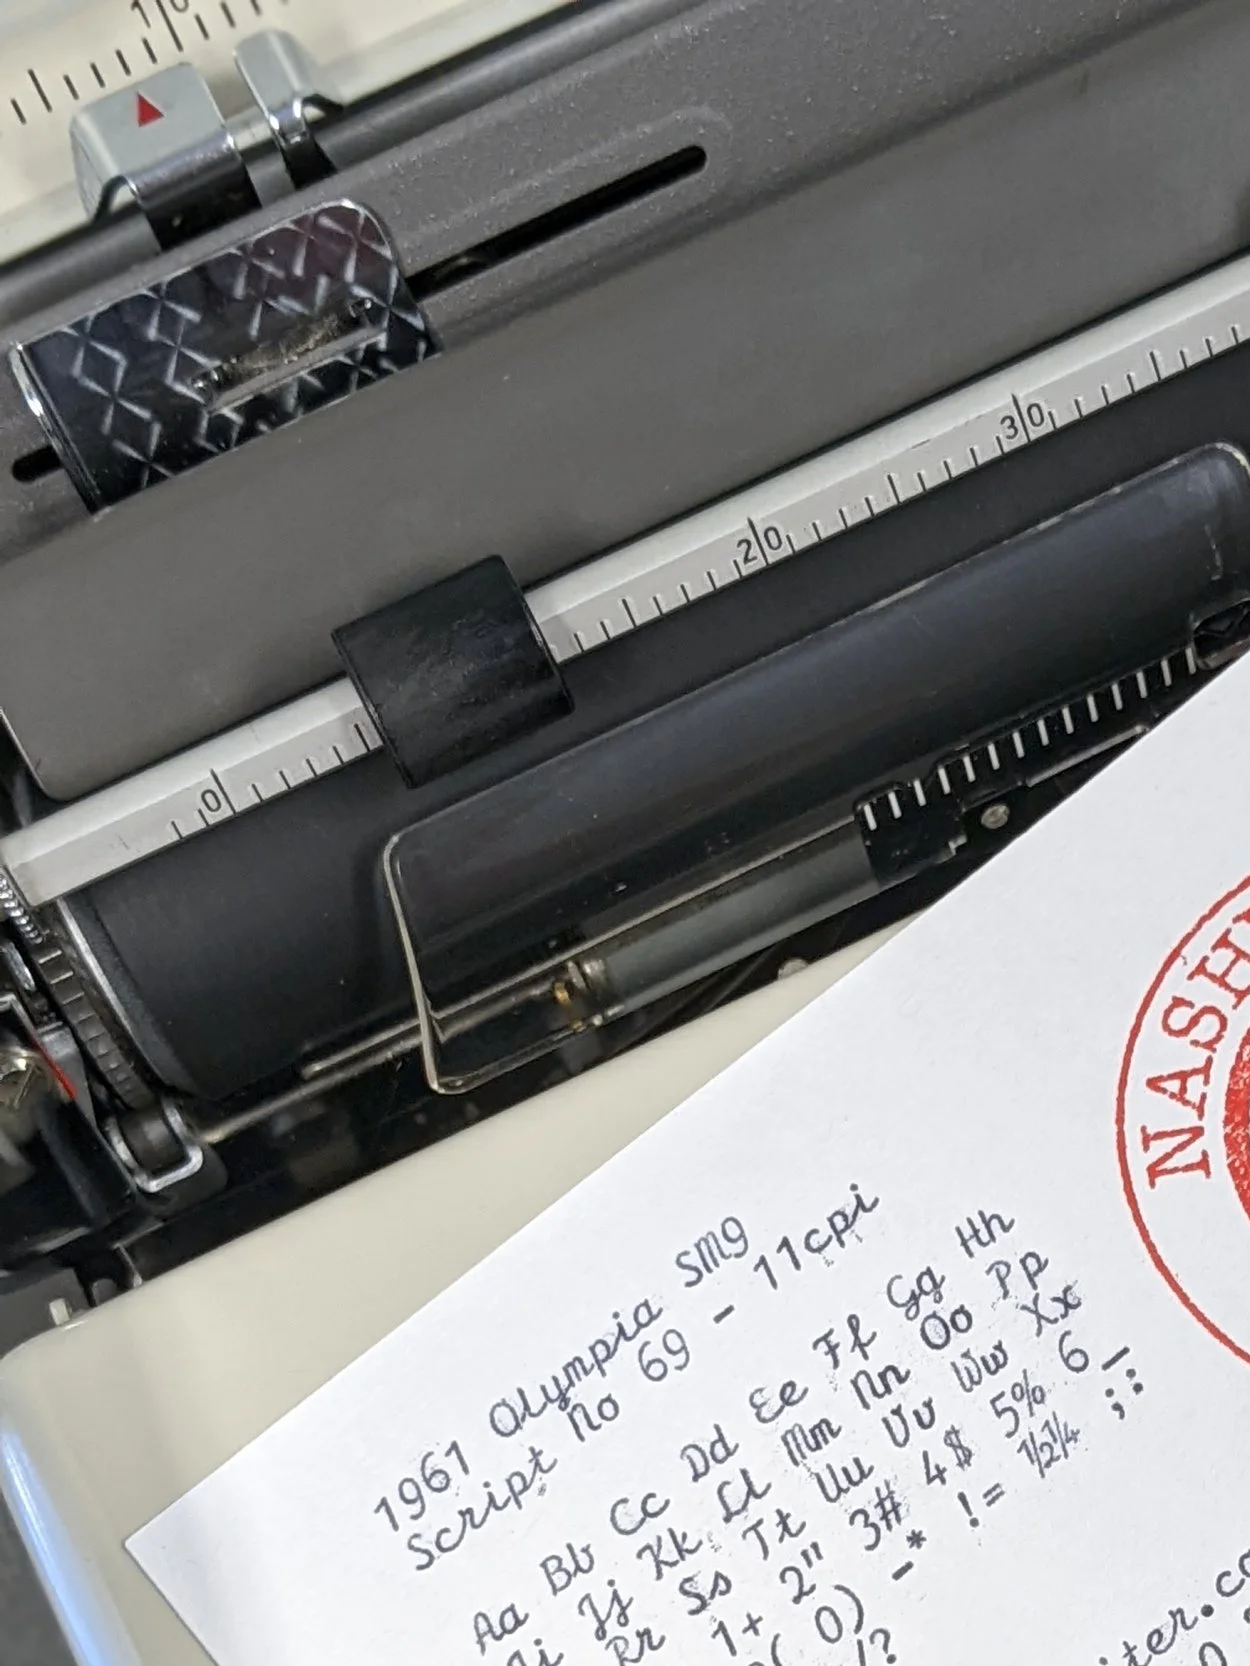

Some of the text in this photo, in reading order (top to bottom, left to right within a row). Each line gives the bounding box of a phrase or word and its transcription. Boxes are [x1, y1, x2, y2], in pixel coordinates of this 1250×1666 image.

[736, 526, 783, 566] 20
[999, 400, 1046, 441] 30
[201, 789, 221, 812] 0
[374, 1216, 749, 1531] 1961 Olympia SM9
[406, 1446, 557, 1571] Script
[637, 1329, 690, 1382] 69
[753, 1183, 880, 1290] 11cpi
[473, 1209, 1015, 1656] Aa Bb Cc Dd Ee Ff Gg Hh
[636, 1527, 703, 1581] Kk
[780, 1417, 842, 1467] Mm
[850, 1363, 911, 1410] Nn
[920, 1304, 972, 1351] Oo
[985, 1251, 1049, 1301] Pp
[678, 1570, 732, 1617] Ss
[742, 1508, 806, 1561] Tt
[814, 1456, 874, 1503] Uu
[881, 1397, 936, 1449] Vv
[950, 1340, 1009, 1394] Ww
[1020, 1285, 1082, 1337] Xx
[711, 1612, 763, 1657] 1+
[849, 1480, 903, 1552] 3#
[922, 1424, 973, 1486] 4$
[989, 1368, 1046, 1439] 5%
